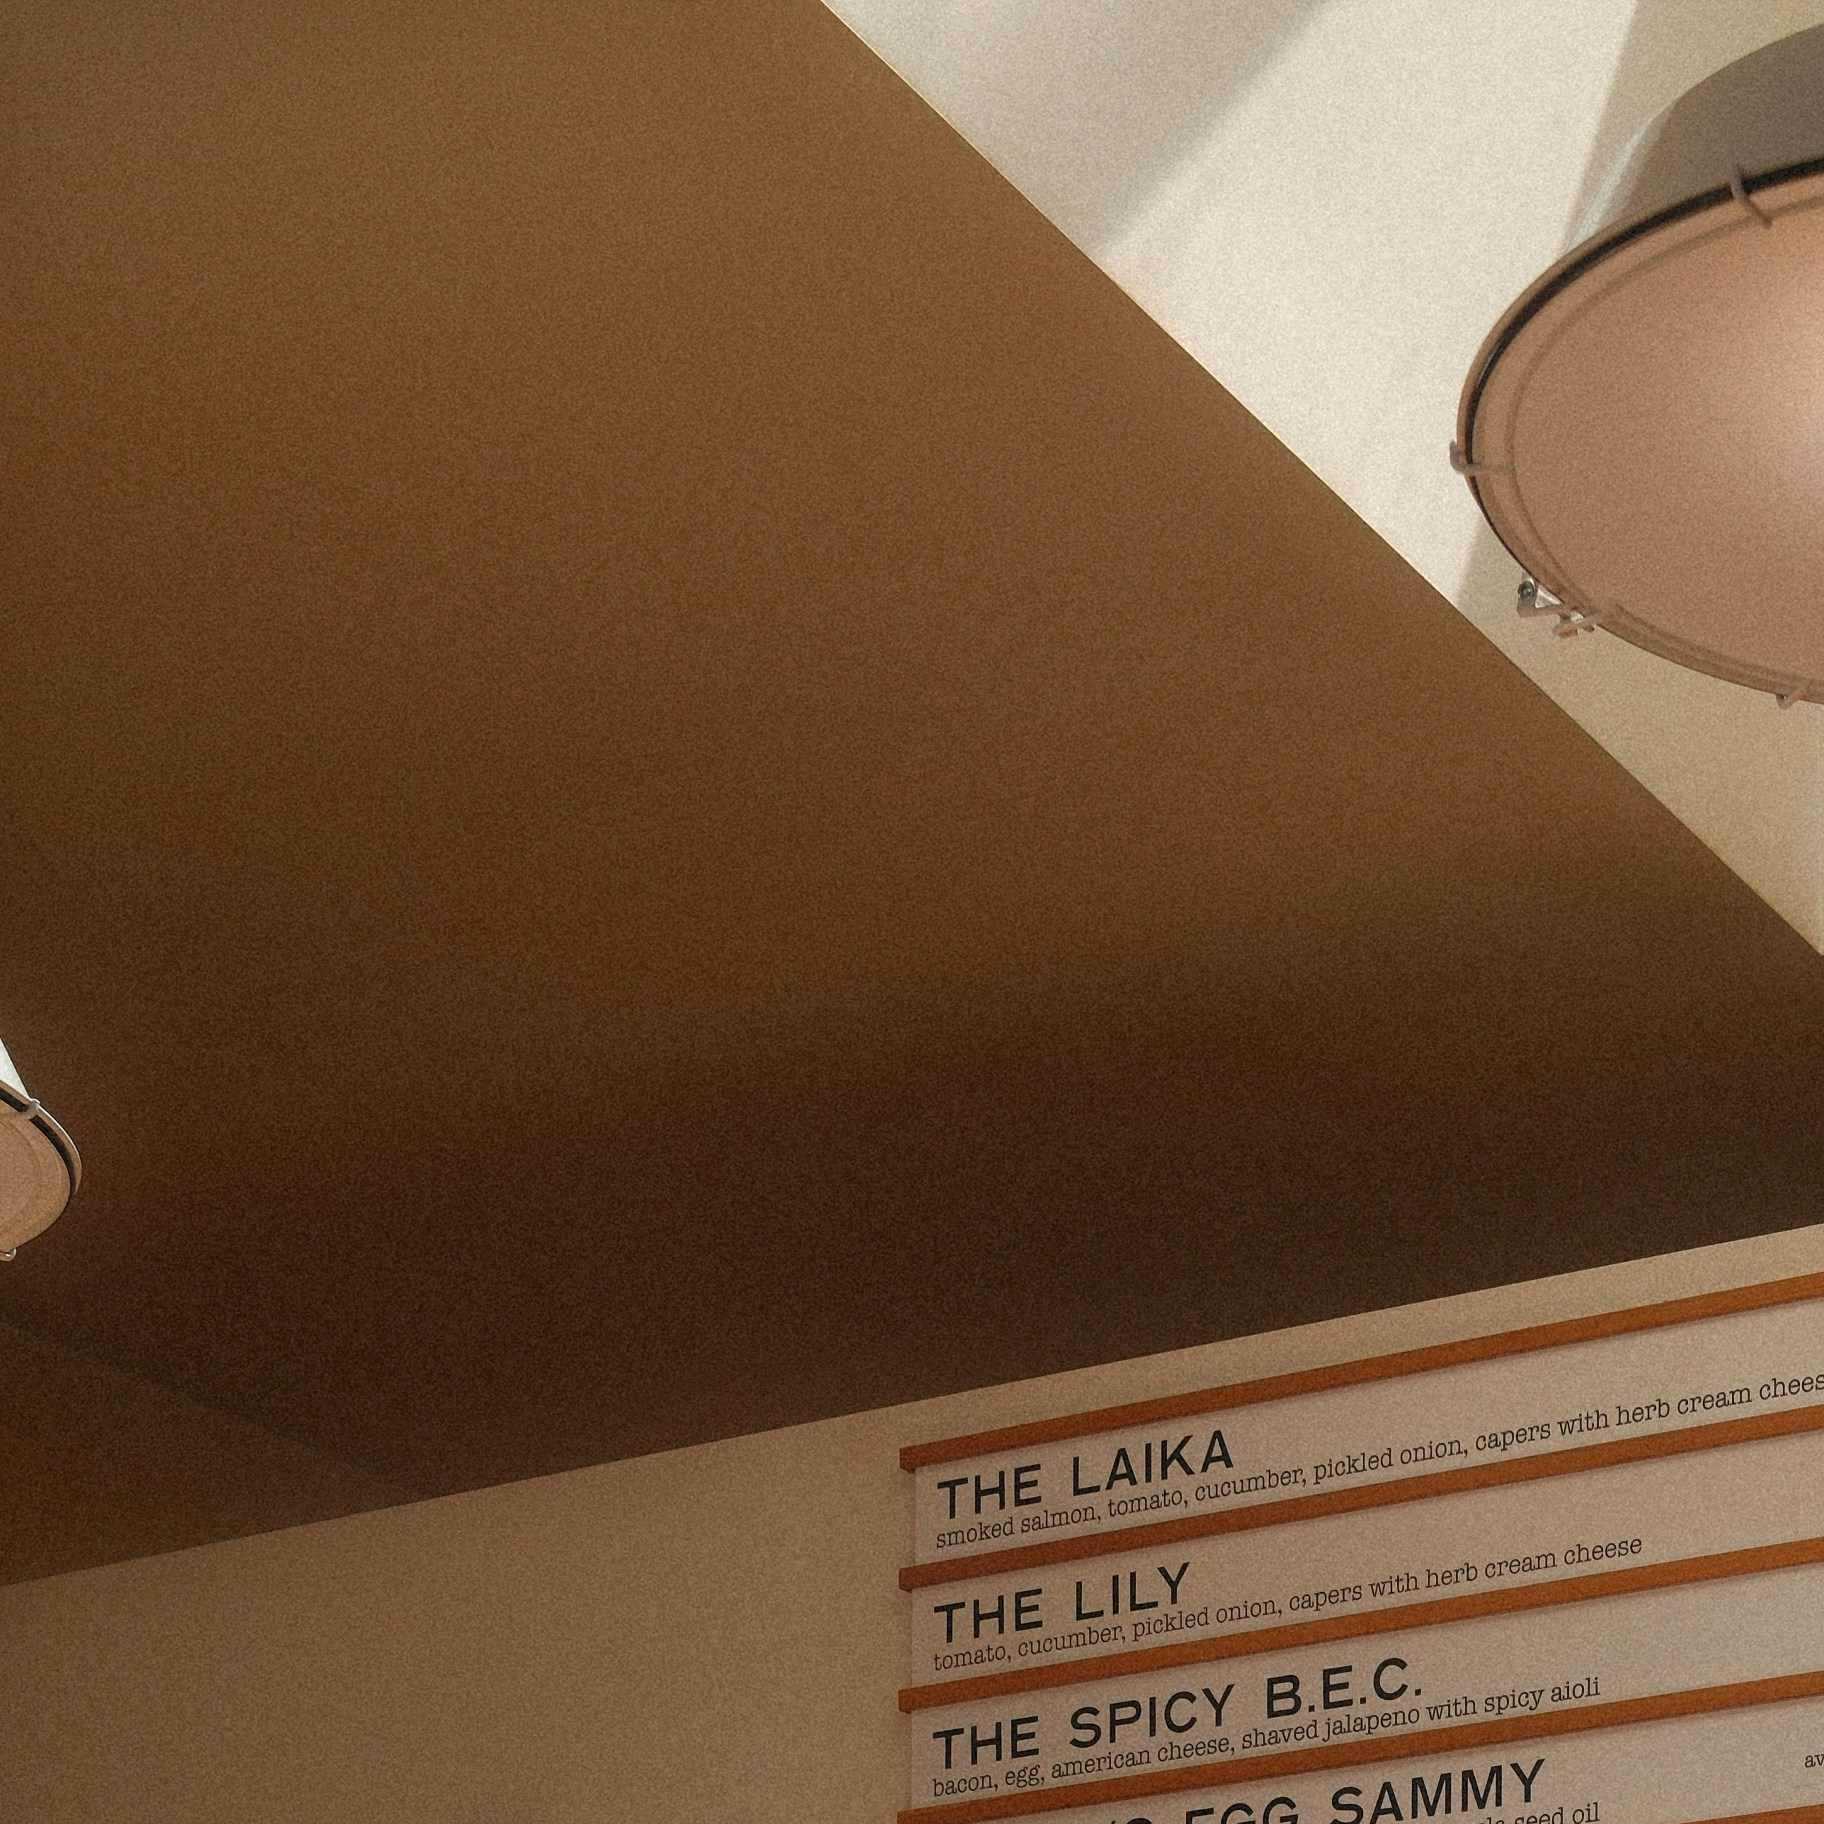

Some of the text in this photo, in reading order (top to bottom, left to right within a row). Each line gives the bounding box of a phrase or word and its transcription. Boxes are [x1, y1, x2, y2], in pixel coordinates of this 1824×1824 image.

[937, 1517, 1014, 1548] smoked
[1021, 1507, 1101, 1533] salmon,
[1108, 1490, 1188, 1517] tomato,
[1195, 1468, 1306, 1501] cucumber,
[1314, 1448, 1393, 1484] pickled
[1400, 1440, 1468, 1464] onion,
[1476, 1423, 1550, 1451] capers
[1558, 1410, 1609, 1435] with
[1617, 1399, 1670, 1425] herb
[1677, 1388, 1751, 1414] cream
[937, 1430, 1233, 1519] THE LAIKA
[933, 1562, 1189, 1643] THE LILY
[932, 1657, 1421, 1769] THE SPICY B.E.C.
[934, 1678, 1599, 1796] bacon, egg, american cheese, shaved jalapeno with spicy aioli
[1572, 1802, 1599, 1824] oil
